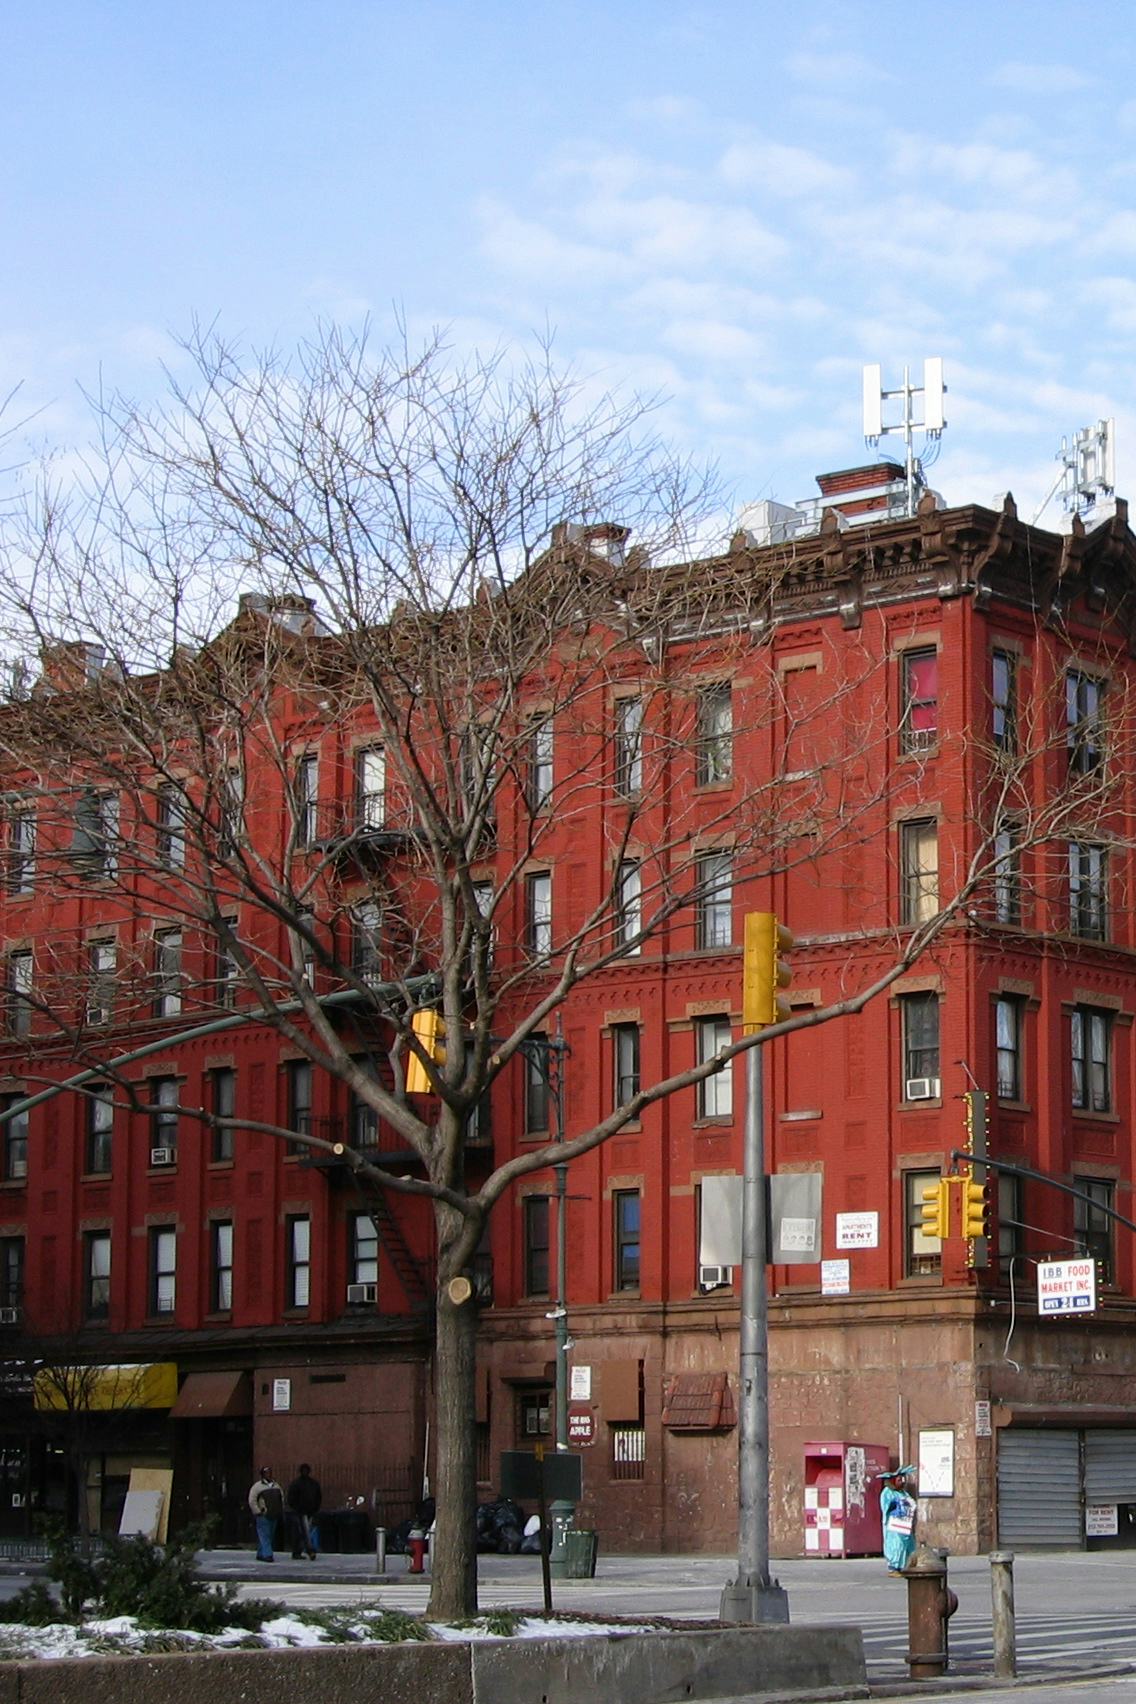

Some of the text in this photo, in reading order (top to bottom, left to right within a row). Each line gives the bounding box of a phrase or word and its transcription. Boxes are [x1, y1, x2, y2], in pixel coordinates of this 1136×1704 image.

[842, 1232, 872, 1240] RENT
[1067, 1264, 1091, 1277] FOOD
[1041, 1281, 1073, 1293] MARKET
[570, 1416, 579, 1424] THE
[570, 1426, 591, 1435] APPLE
